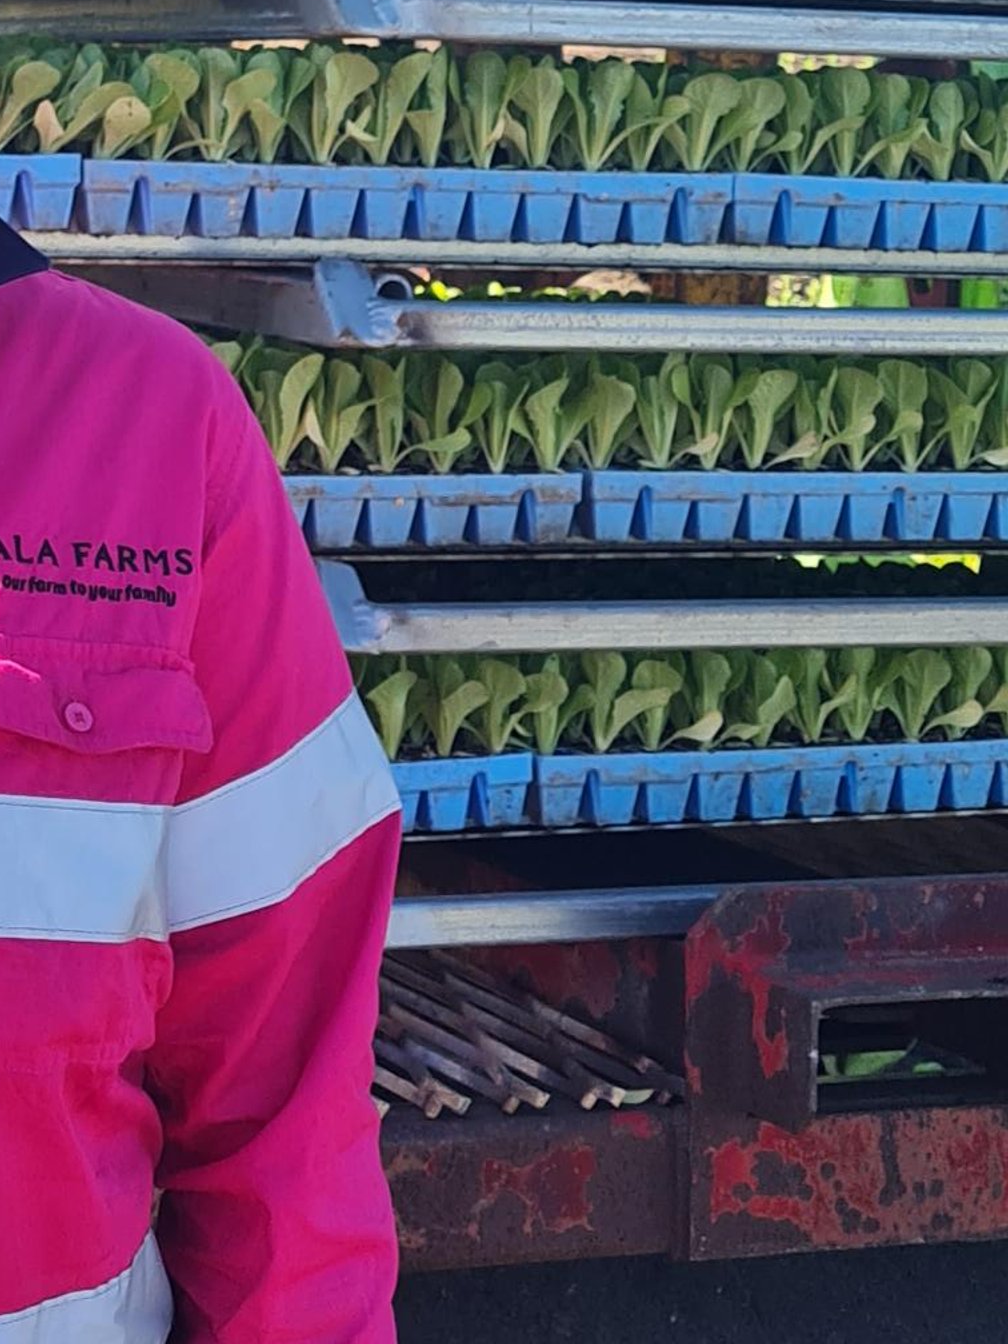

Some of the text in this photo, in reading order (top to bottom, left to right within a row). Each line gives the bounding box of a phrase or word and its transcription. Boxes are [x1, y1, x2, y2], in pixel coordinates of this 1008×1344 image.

[71, 542, 194, 576] FARMS
[28, 575, 67, 595] farm
[69, 579, 86, 596] to
[88, 583, 123, 601] your
[124, 584, 176, 607] family
